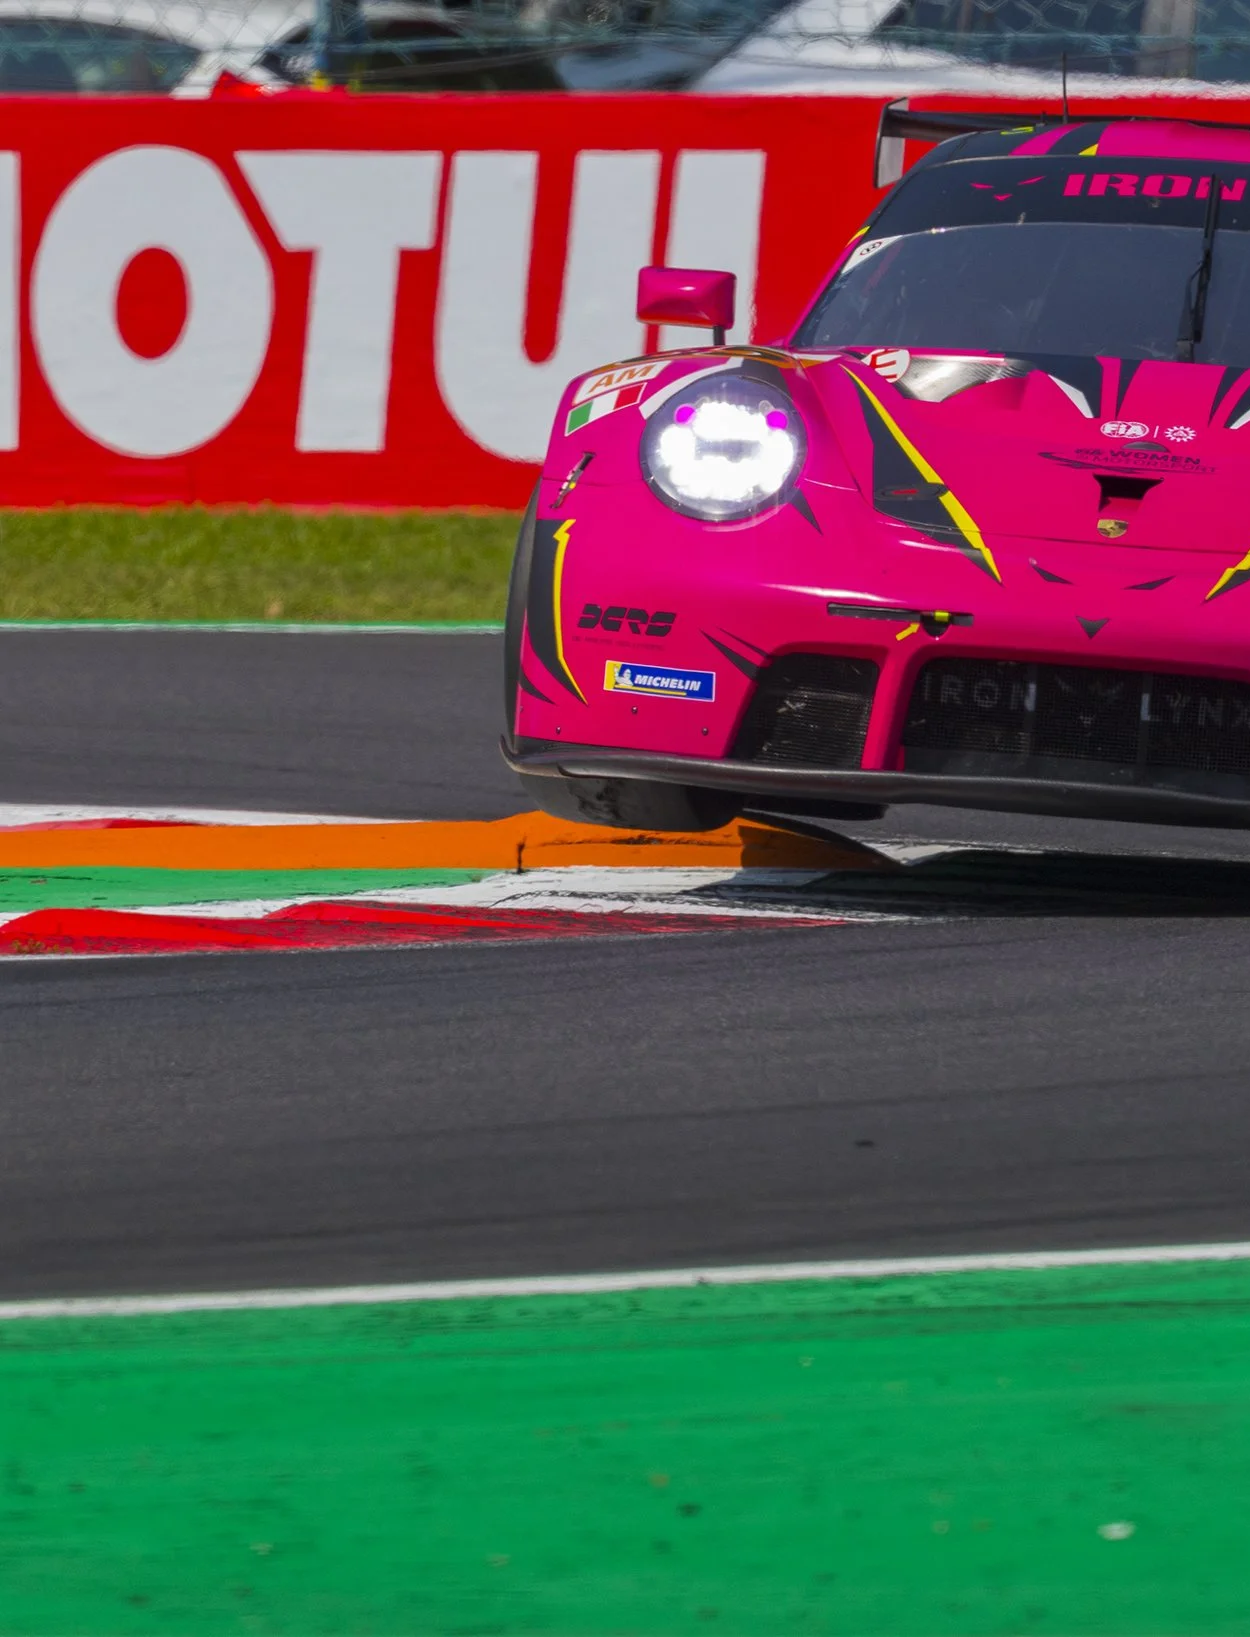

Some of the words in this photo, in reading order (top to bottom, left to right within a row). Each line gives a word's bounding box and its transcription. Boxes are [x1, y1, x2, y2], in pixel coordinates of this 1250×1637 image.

[1063, 173, 1247, 201] IRON
[0, 143, 767, 463] OTU
[588, 364, 656, 393] AM
[1102, 423, 1145, 437] FIA
[1109, 450, 1201, 465] WOMEN
[634, 673, 702, 692] MICHELIN
[923, 671, 1037, 712] IRON
